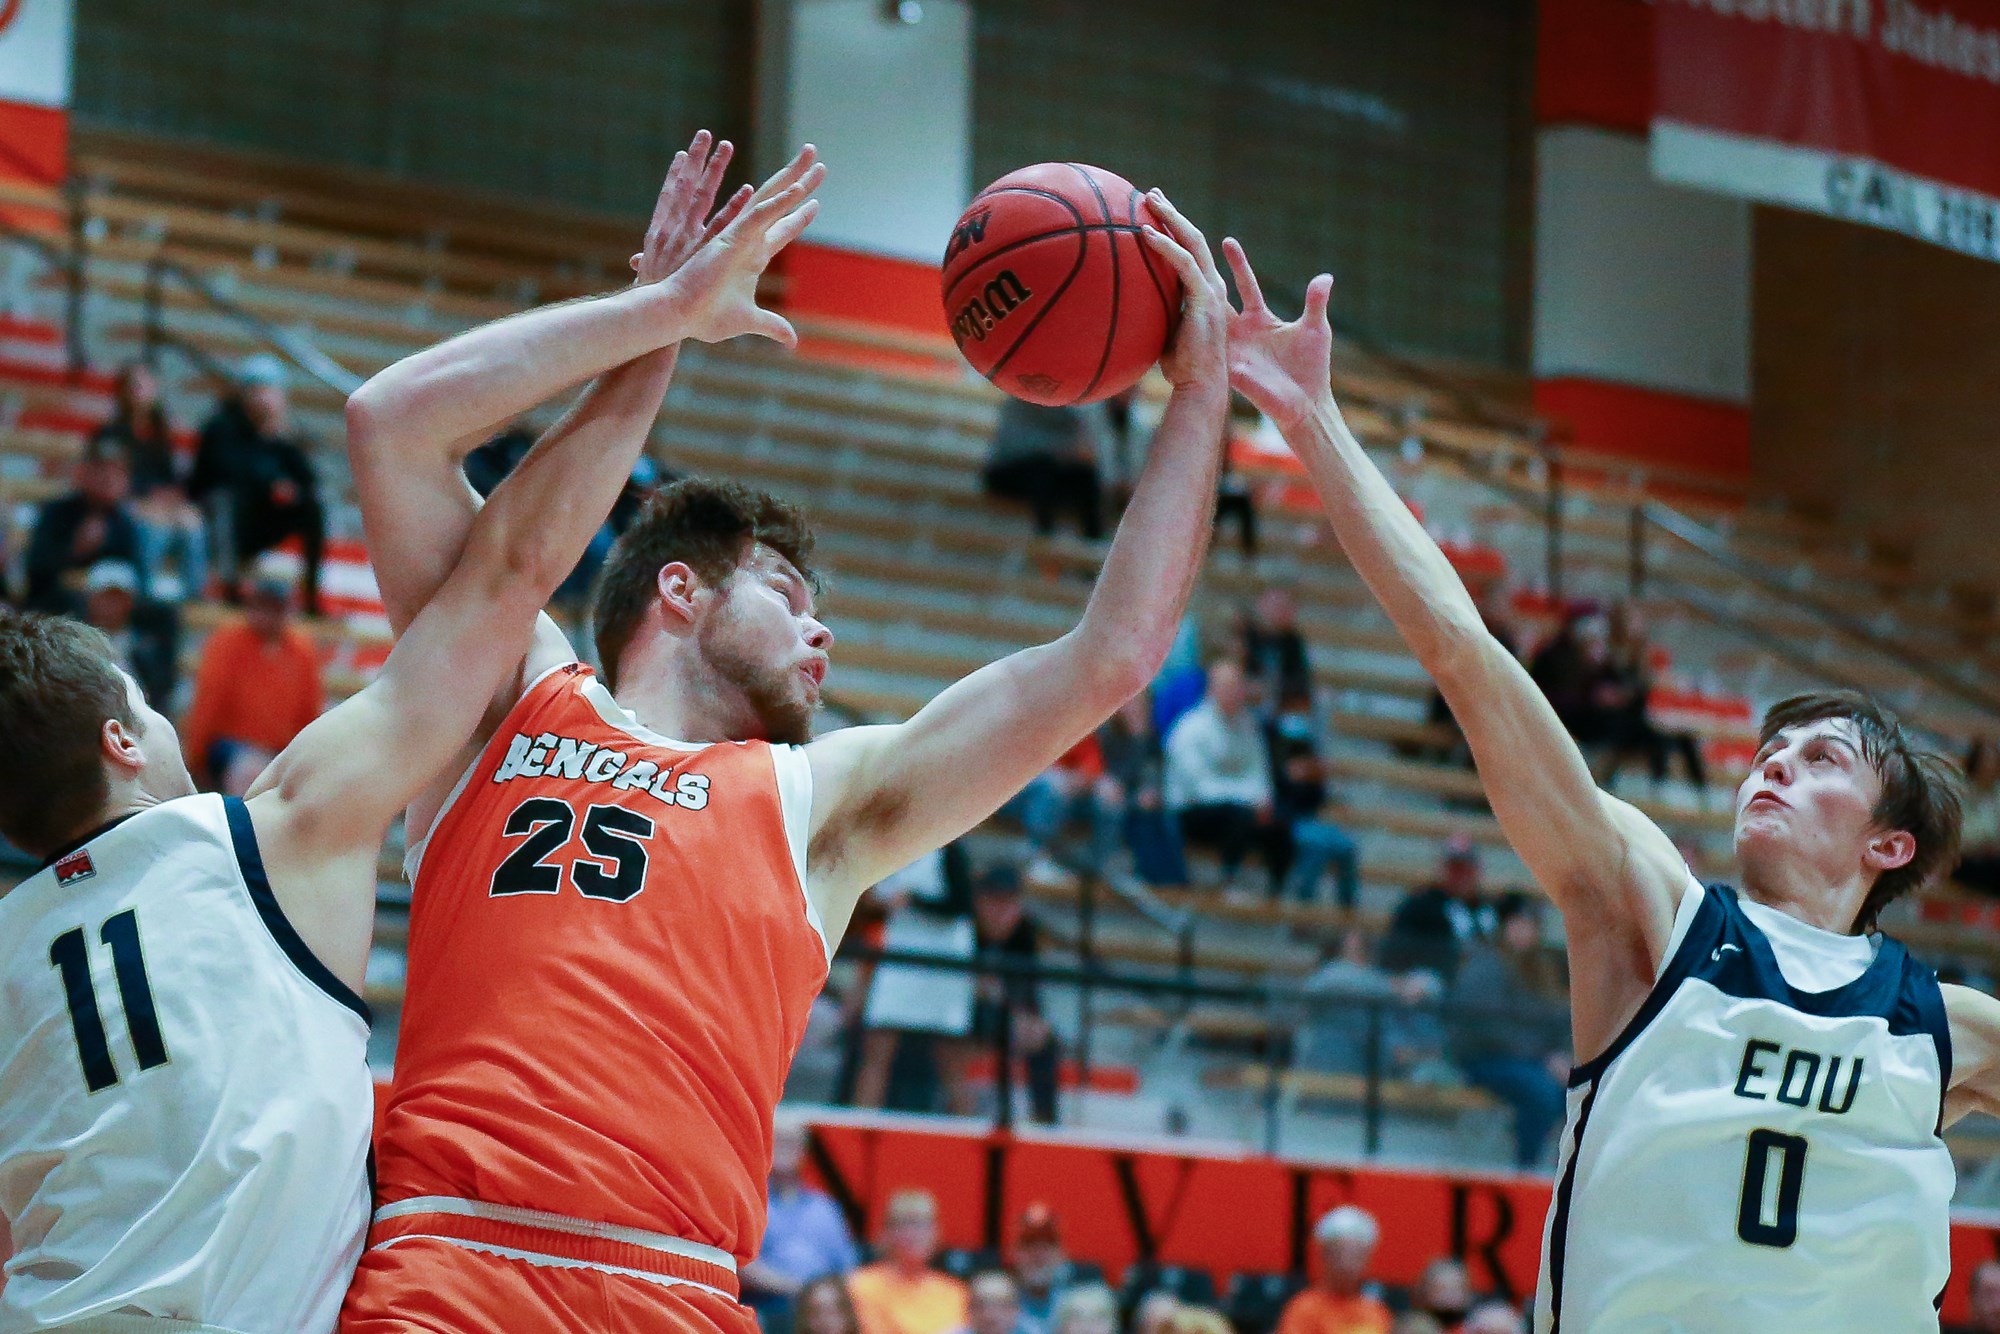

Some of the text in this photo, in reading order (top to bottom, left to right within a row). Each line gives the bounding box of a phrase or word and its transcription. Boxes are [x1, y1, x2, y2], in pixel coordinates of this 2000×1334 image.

[493, 732, 710, 811] BENGALS
[489, 797, 655, 904] 25
[48, 905, 172, 1096] 11
[1733, 1037, 1865, 1114] EOU
[1735, 1127, 1809, 1248] 0
